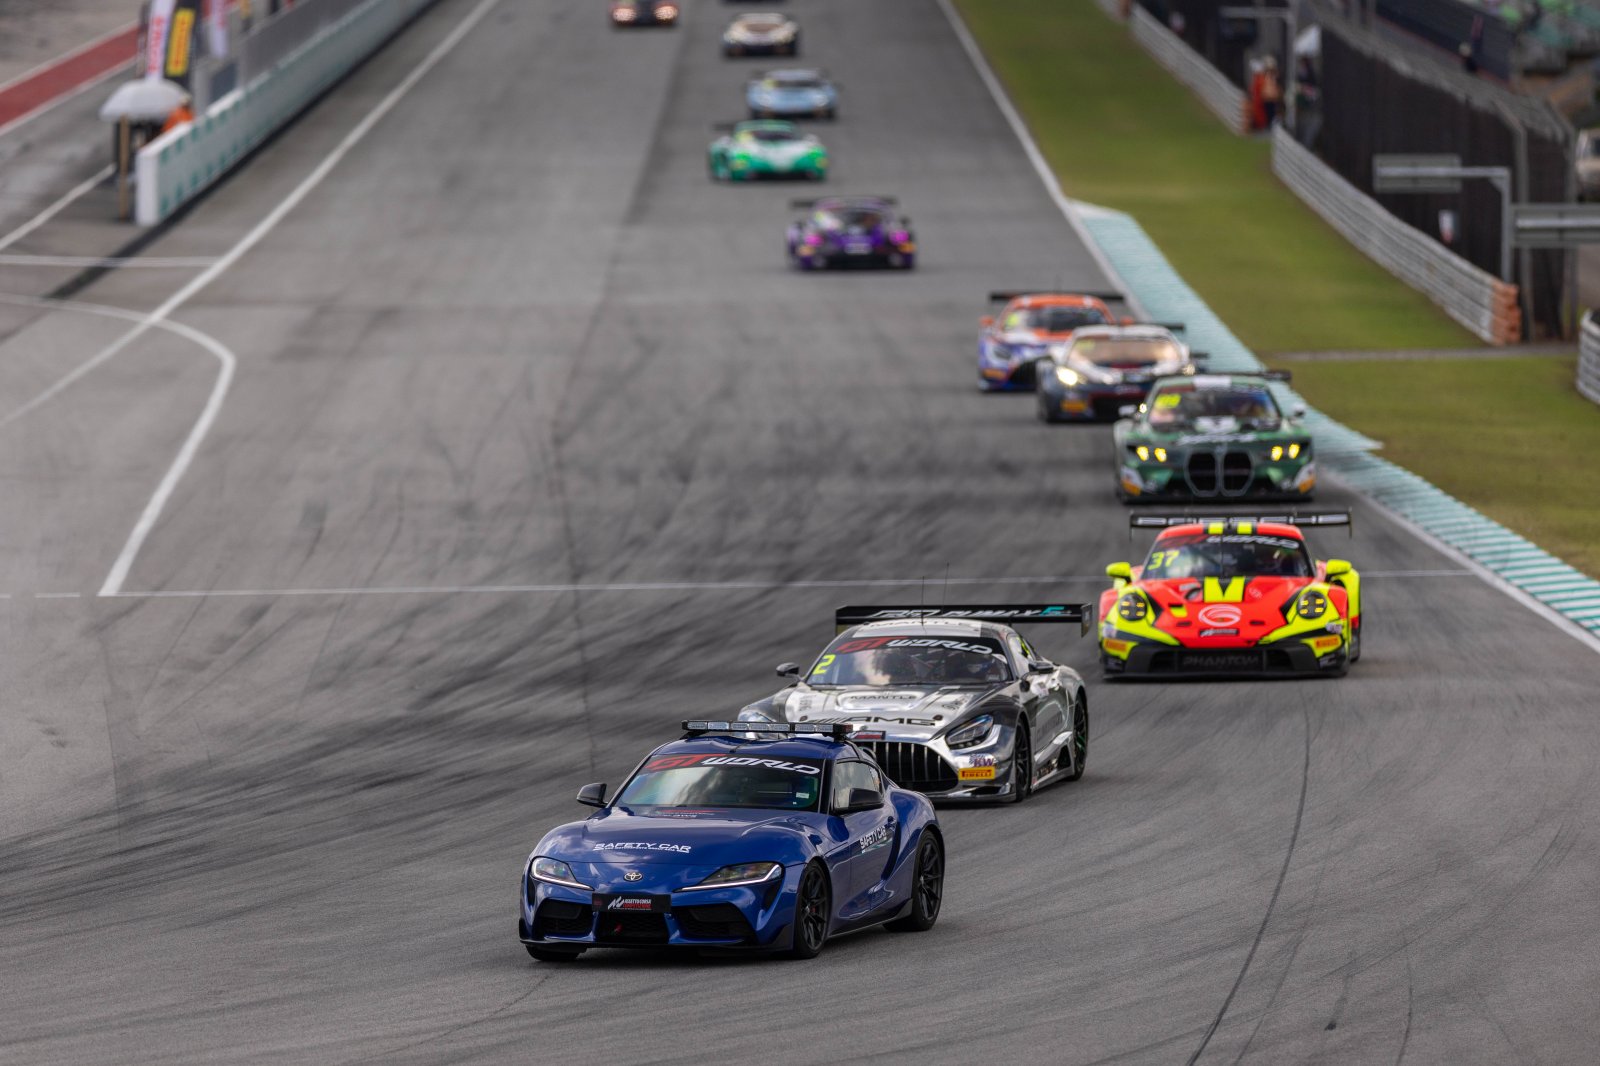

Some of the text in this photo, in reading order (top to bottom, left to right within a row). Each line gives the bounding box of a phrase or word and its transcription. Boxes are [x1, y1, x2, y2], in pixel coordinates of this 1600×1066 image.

[1206, 535, 1299, 549] WORLD
[1148, 550, 1180, 570] 37
[834, 635, 993, 655] GT WORLD
[812, 654, 836, 675] 2
[1183, 656, 1259, 666] PHANTOM
[842, 715, 936, 726] AMG
[645, 753, 820, 775] GT WORLD
[961, 769, 992, 778] PIRELLI
[593, 842, 657, 851] SAFETY
[658, 843, 692, 854] CAR
[860, 829, 878, 850] SAFETY
